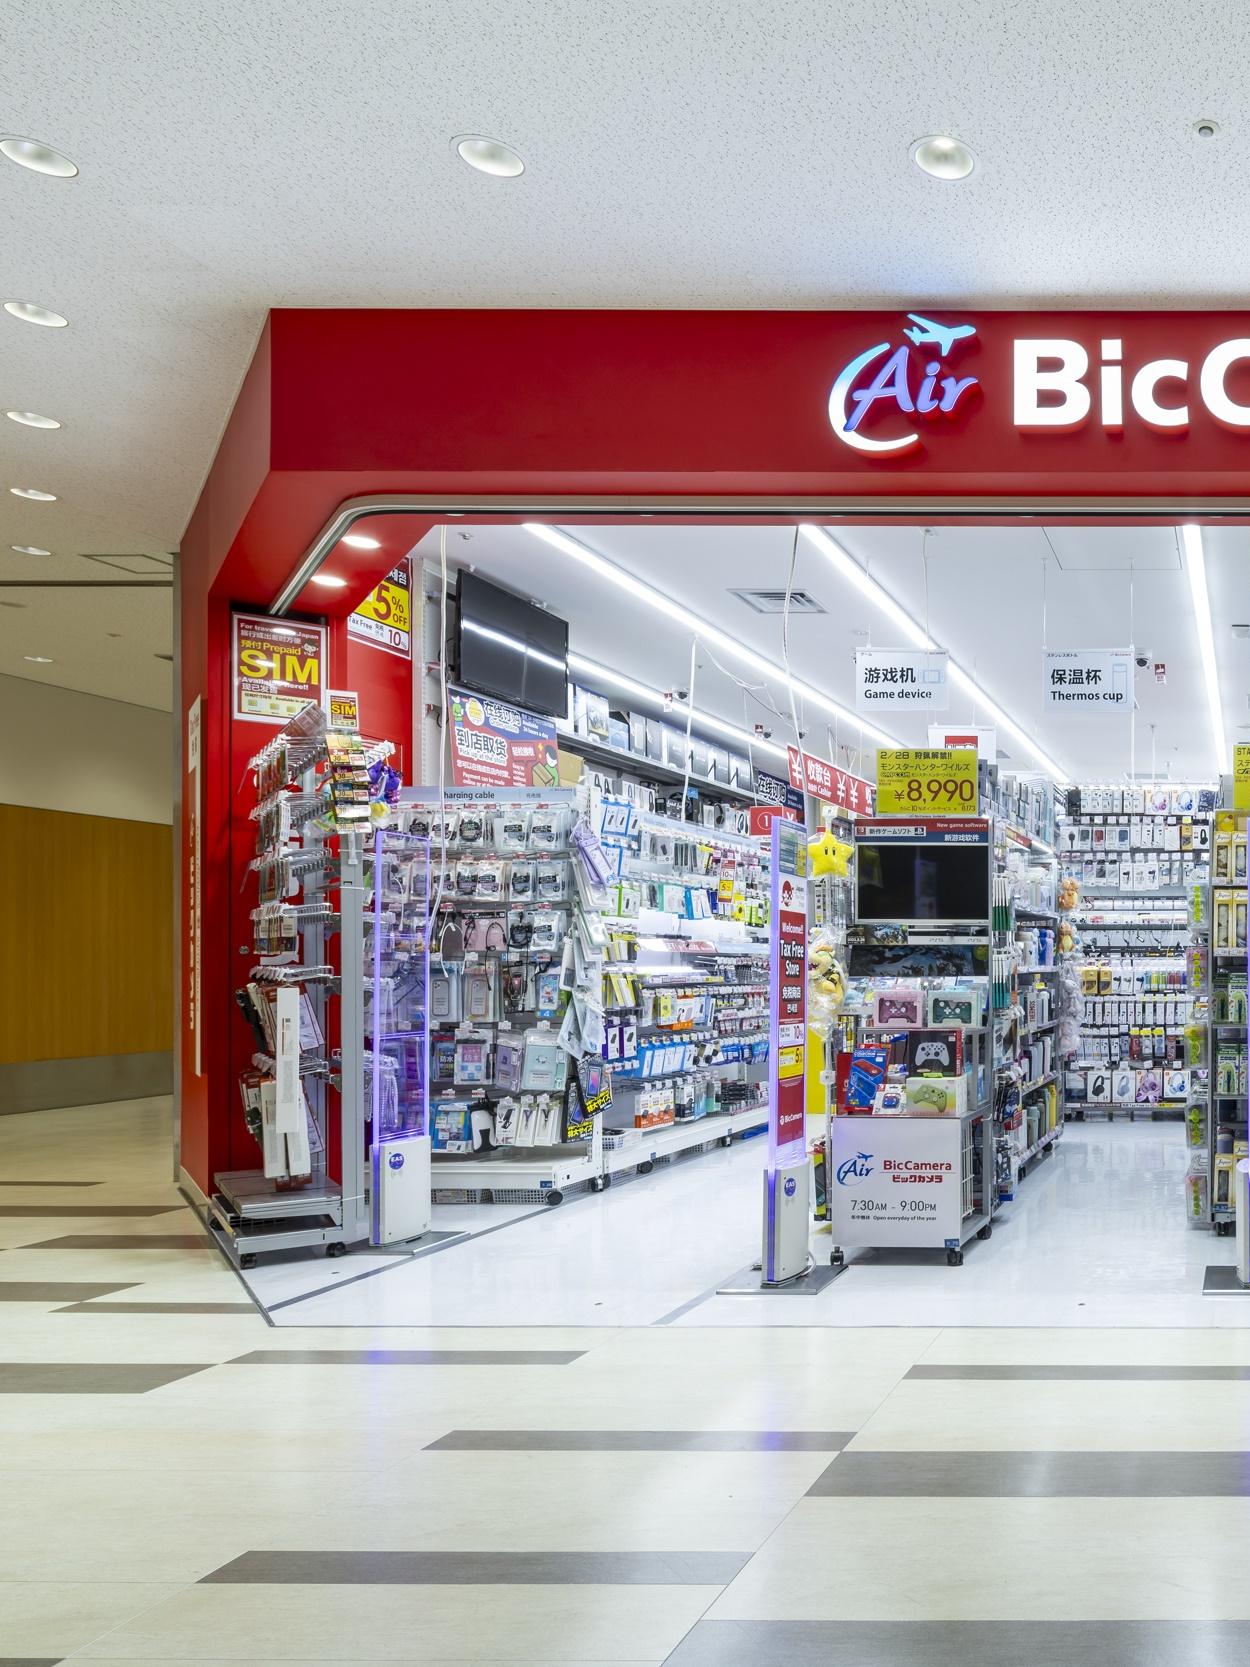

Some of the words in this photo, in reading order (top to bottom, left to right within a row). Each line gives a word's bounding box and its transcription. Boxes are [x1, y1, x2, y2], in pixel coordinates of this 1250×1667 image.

[844, 344, 980, 432] Air
[360, 619, 373, 631] Free
[392, 613, 407, 627] OFF
[240, 622, 253, 632] For
[297, 631, 319, 641] Japan
[263, 641, 302, 656] Prepaid
[239, 649, 319, 685] SIM
[864, 666, 917, 684] 游戏机
[1050, 668, 1102, 686] 保温杯
[864, 689, 896, 699] Game
[897, 688, 932, 699] device
[1050, 690, 1100, 701] Thermos
[1102, 692, 1124, 703] cup
[330, 703, 356, 716] SIM
[456, 728, 507, 759] 到店取货
[880, 751, 910, 760] 2/28
[880, 763, 971, 772] モンスターハンターワイルズ
[807, 759, 832, 788] 收款台
[836, 771, 847, 803] ¥
[849, 777, 859, 809] ¥
[444, 791, 473, 801] harging
[475, 791, 495, 799] cable
[906, 778, 975, 804] 8,990
[944, 833, 980, 842] 新游戏软件
[781, 921, 804, 935] Welcome!!
[780, 939, 792, 957] Tax
[791, 940, 805, 958] Free
[785, 959, 800, 976] Store
[439, 1055, 454, 1064] 防水
[784, 1112, 803, 1124] BicCamera
[840, 1159, 875, 1182] Air
[883, 1159, 952, 1171] BicCamera
[785, 1181, 796, 1189] EAS
[892, 1174, 943, 1184] ビックカメラ
[850, 1199, 888, 1211] 7:30AM
[900, 1199, 937, 1212] 9:00PM
